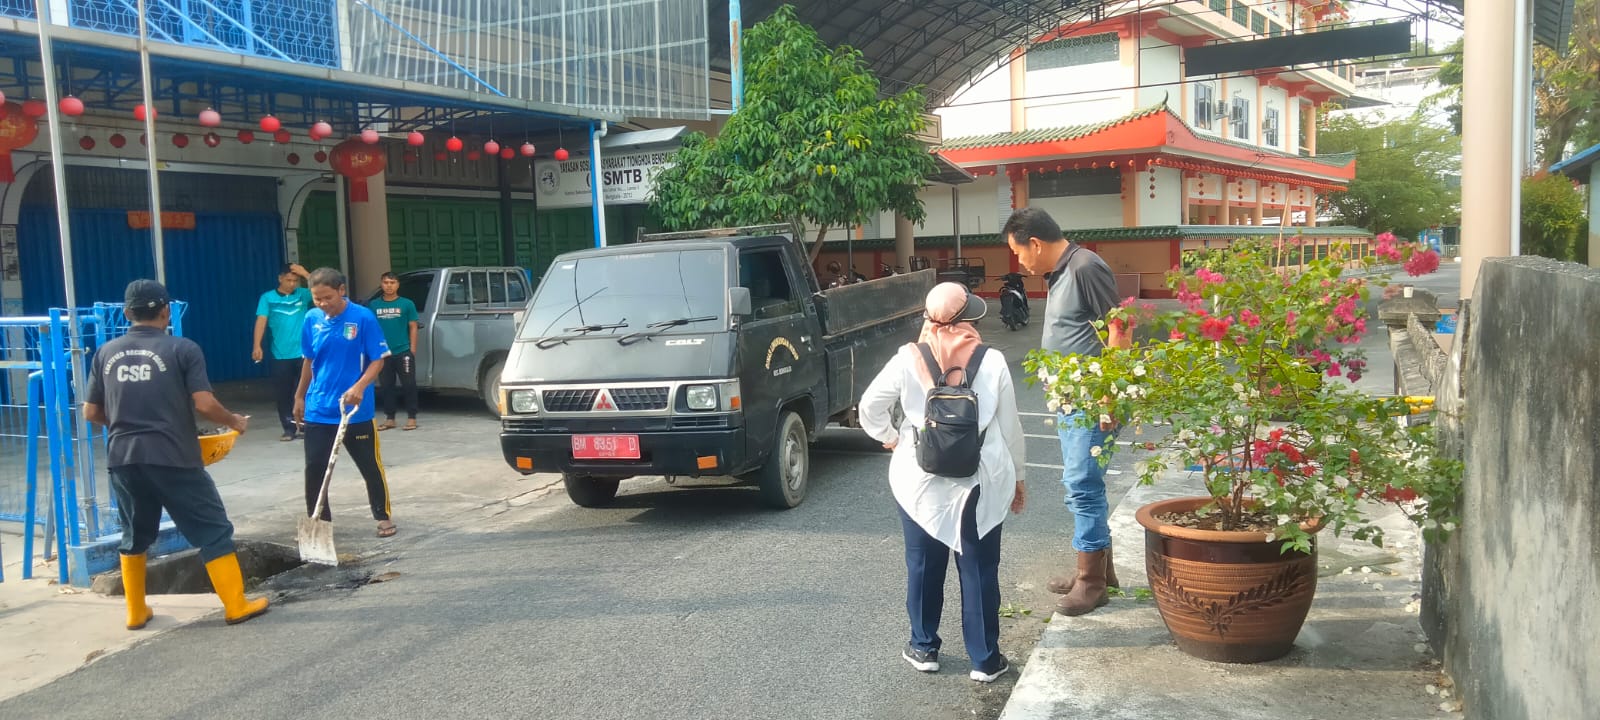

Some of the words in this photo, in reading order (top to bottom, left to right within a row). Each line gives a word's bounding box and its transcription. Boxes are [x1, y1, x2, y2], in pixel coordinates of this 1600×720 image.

[627, 152, 651, 168] TIONGHOA
[665, 338, 706, 346] COLT
[125, 349, 155, 358] SECURITY
[117, 363, 151, 382] CSG
[573, 437, 586, 451] BM
[628, 437, 636, 451] D
